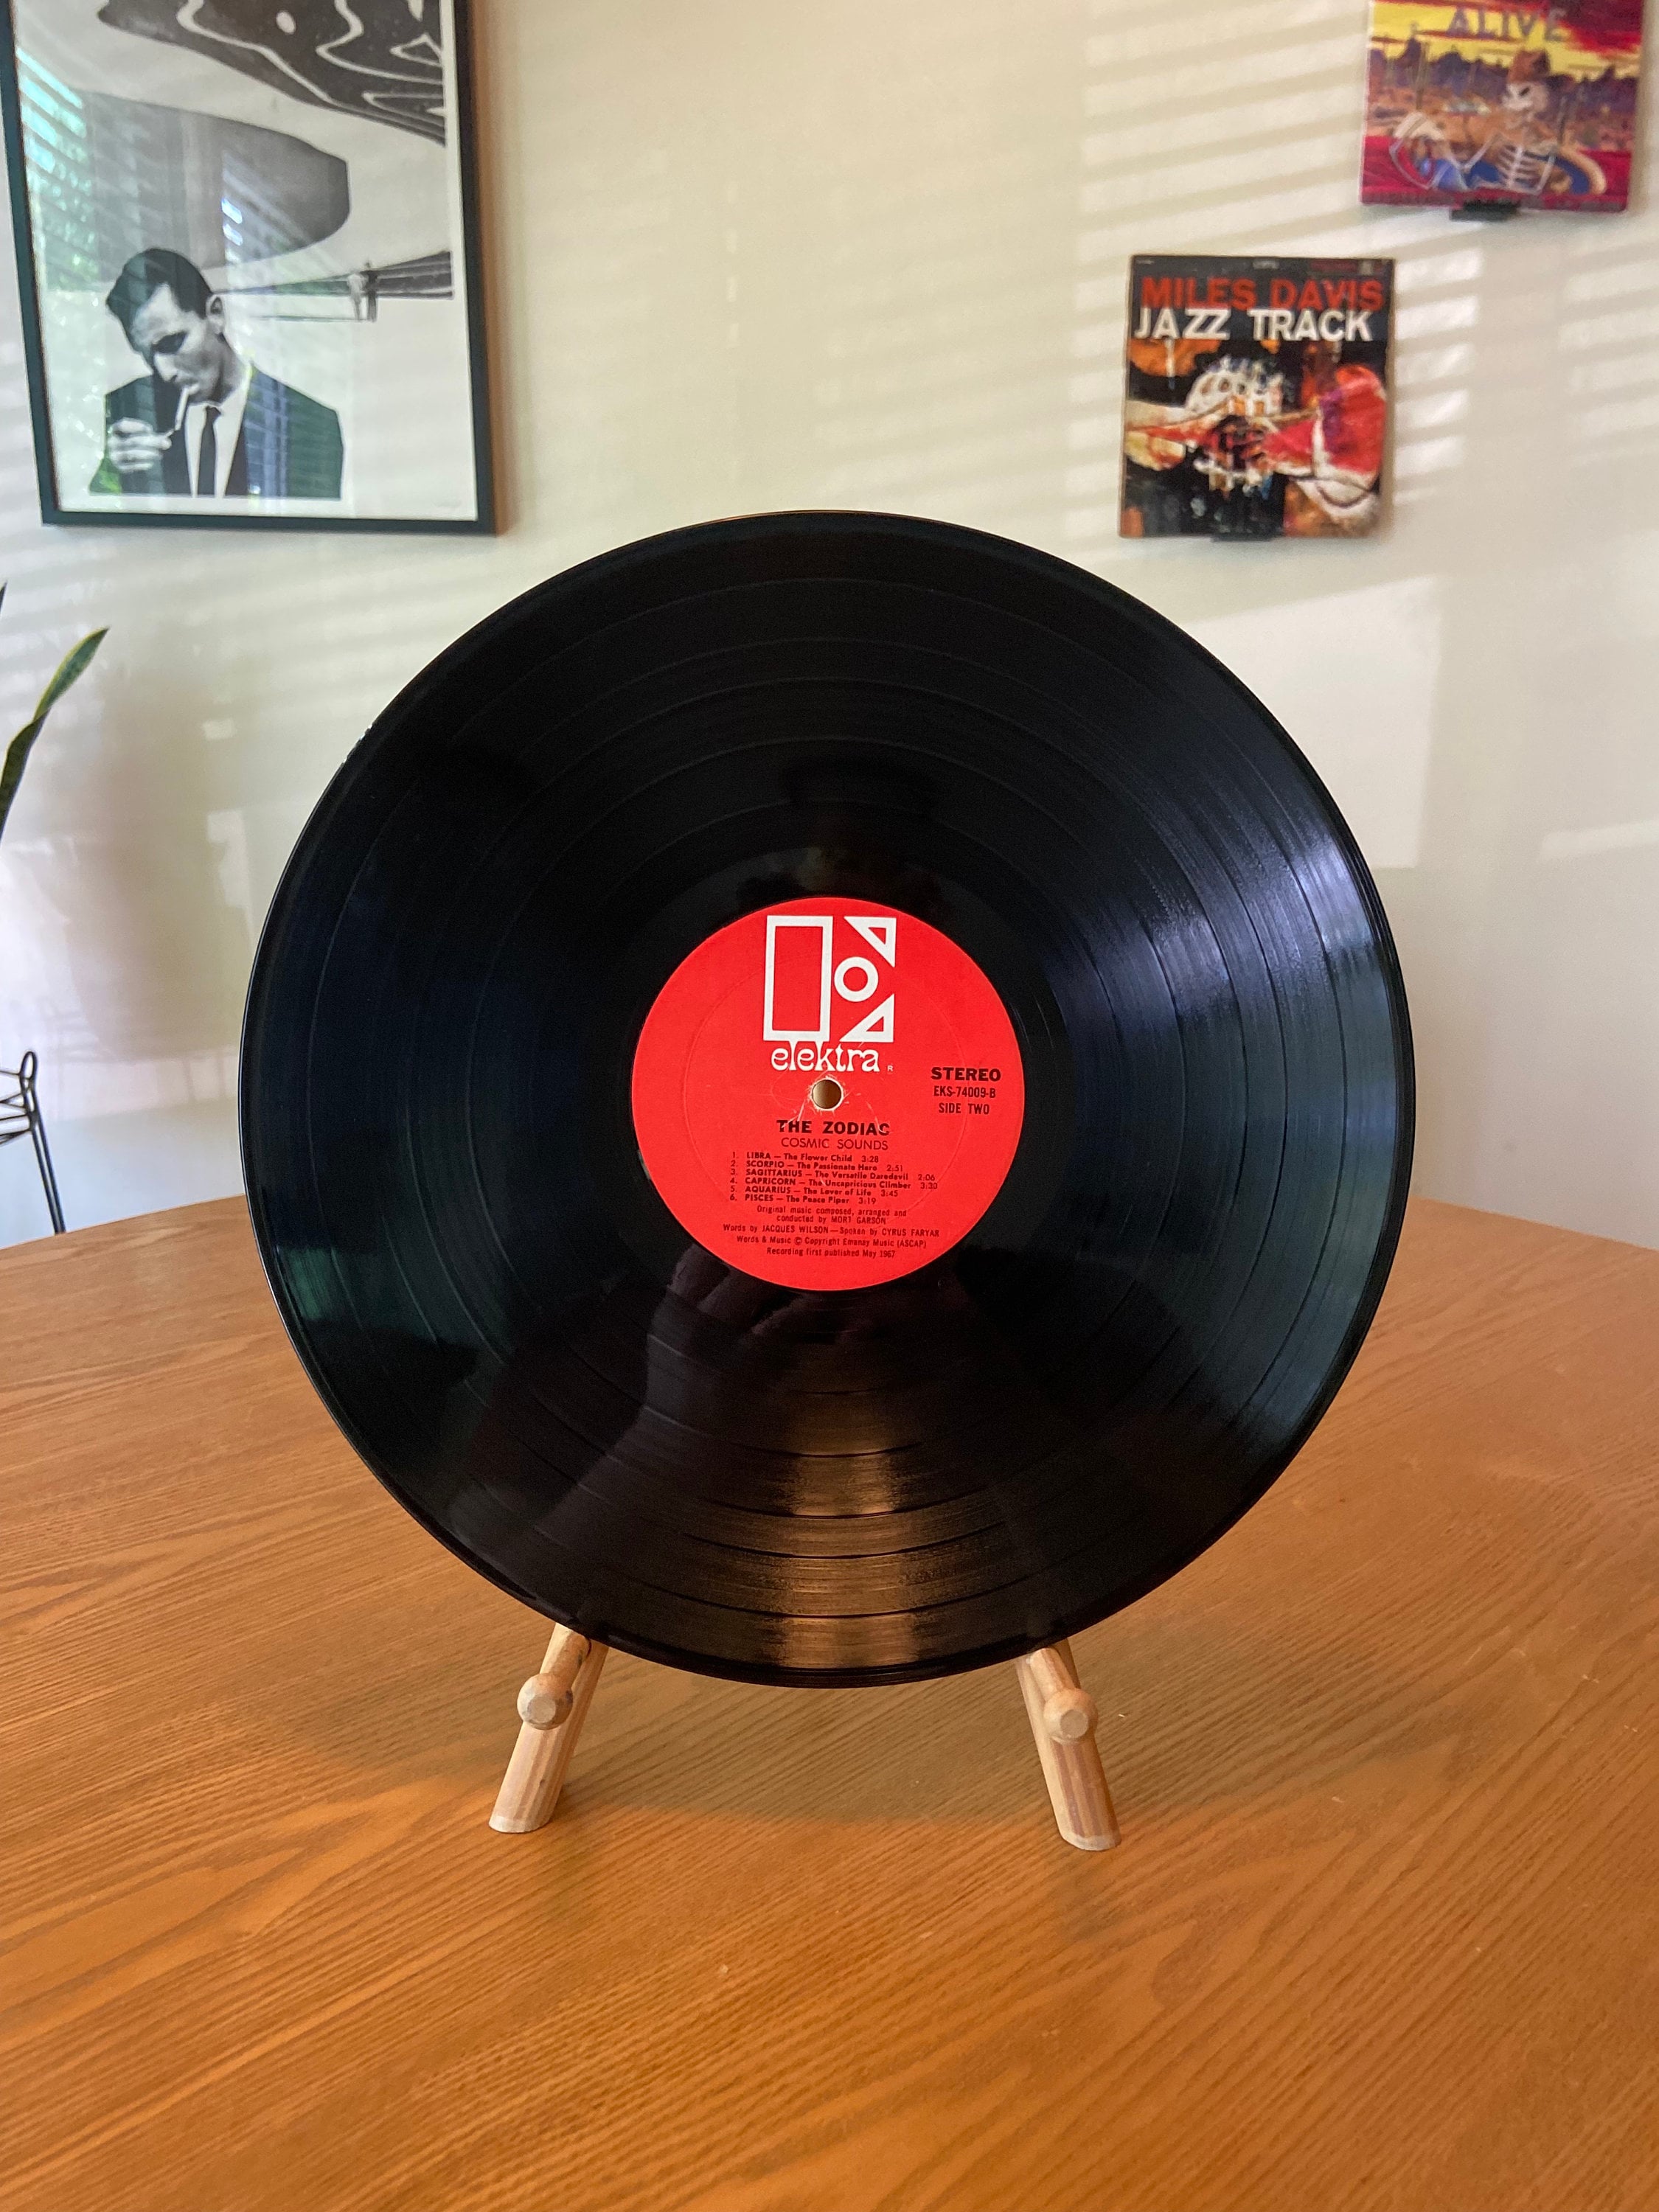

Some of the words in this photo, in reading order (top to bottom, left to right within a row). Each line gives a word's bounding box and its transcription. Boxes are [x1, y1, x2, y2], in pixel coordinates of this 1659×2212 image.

[1141, 277, 1258, 310] MILES
[1270, 279, 1384, 311] DAVIS
[1134, 307, 1231, 340] JAZZ
[1247, 308, 1374, 341] TRACK
[771, 1041, 880, 1072] elektra
[931, 1066, 1001, 1082] STEREO
[934, 1085, 995, 1098] EKS-74009-B
[939, 1102, 961, 1114] SIDE
[967, 1103, 990, 1115] TWO
[776, 1120, 812, 1133] THE
[822, 1121, 890, 1135] ZODIAC
[781, 1137, 830, 1149] COSMIC
[837, 1138, 888, 1150] SOUNDS
[813, 1162, 855, 1171] Passionate
[746, 1169, 802, 1177] SAGITTARIUS
[832, 1171, 867, 1179] Versatile
[870, 1172, 908, 1180] Daredevil
[745, 1178, 796, 1186] CAPRICORN
[825, 1180, 876, 1189] Uncapricious
[745, 1186, 790, 1194] AQUARIUS
[757, 1205, 786, 1214] Original
[816, 1207, 854, 1216] composed,
[762, 1225, 795, 1233] JACQUES
[840, 1227, 866, 1235] Spoken
[911, 1229, 939, 1237] FARYAR
[805, 1237, 840, 1246] Copyright
[897, 1239, 926, 1248] (ASCAP)
[767, 1248, 803, 1256] Recording
[824, 1248, 859, 1257] published
[863, 1250, 876, 1259] May
